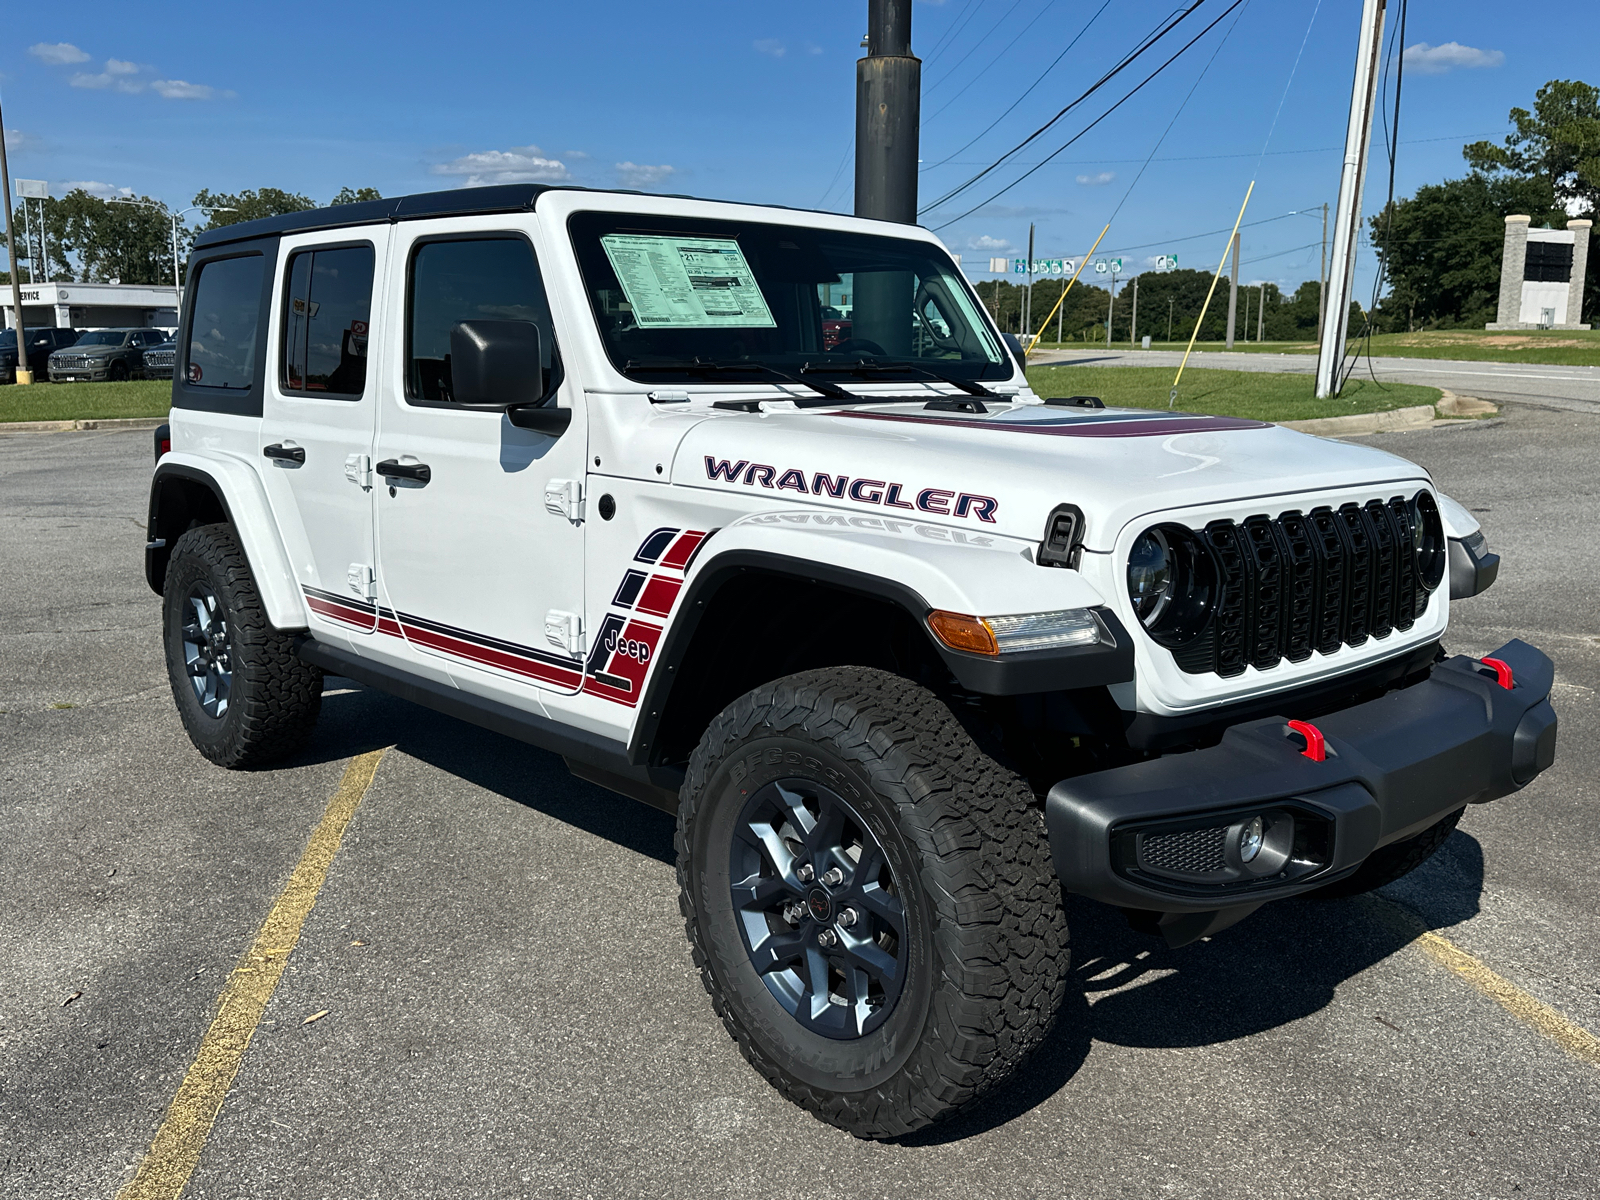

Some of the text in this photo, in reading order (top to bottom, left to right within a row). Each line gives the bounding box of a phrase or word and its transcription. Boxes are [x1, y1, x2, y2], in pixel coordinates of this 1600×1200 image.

[20, 291, 40, 301] ERVICE
[704, 455, 998, 524] WRANGLER
[605, 629, 650, 664] Jeep
[728, 746, 904, 867] BFGoodrich
